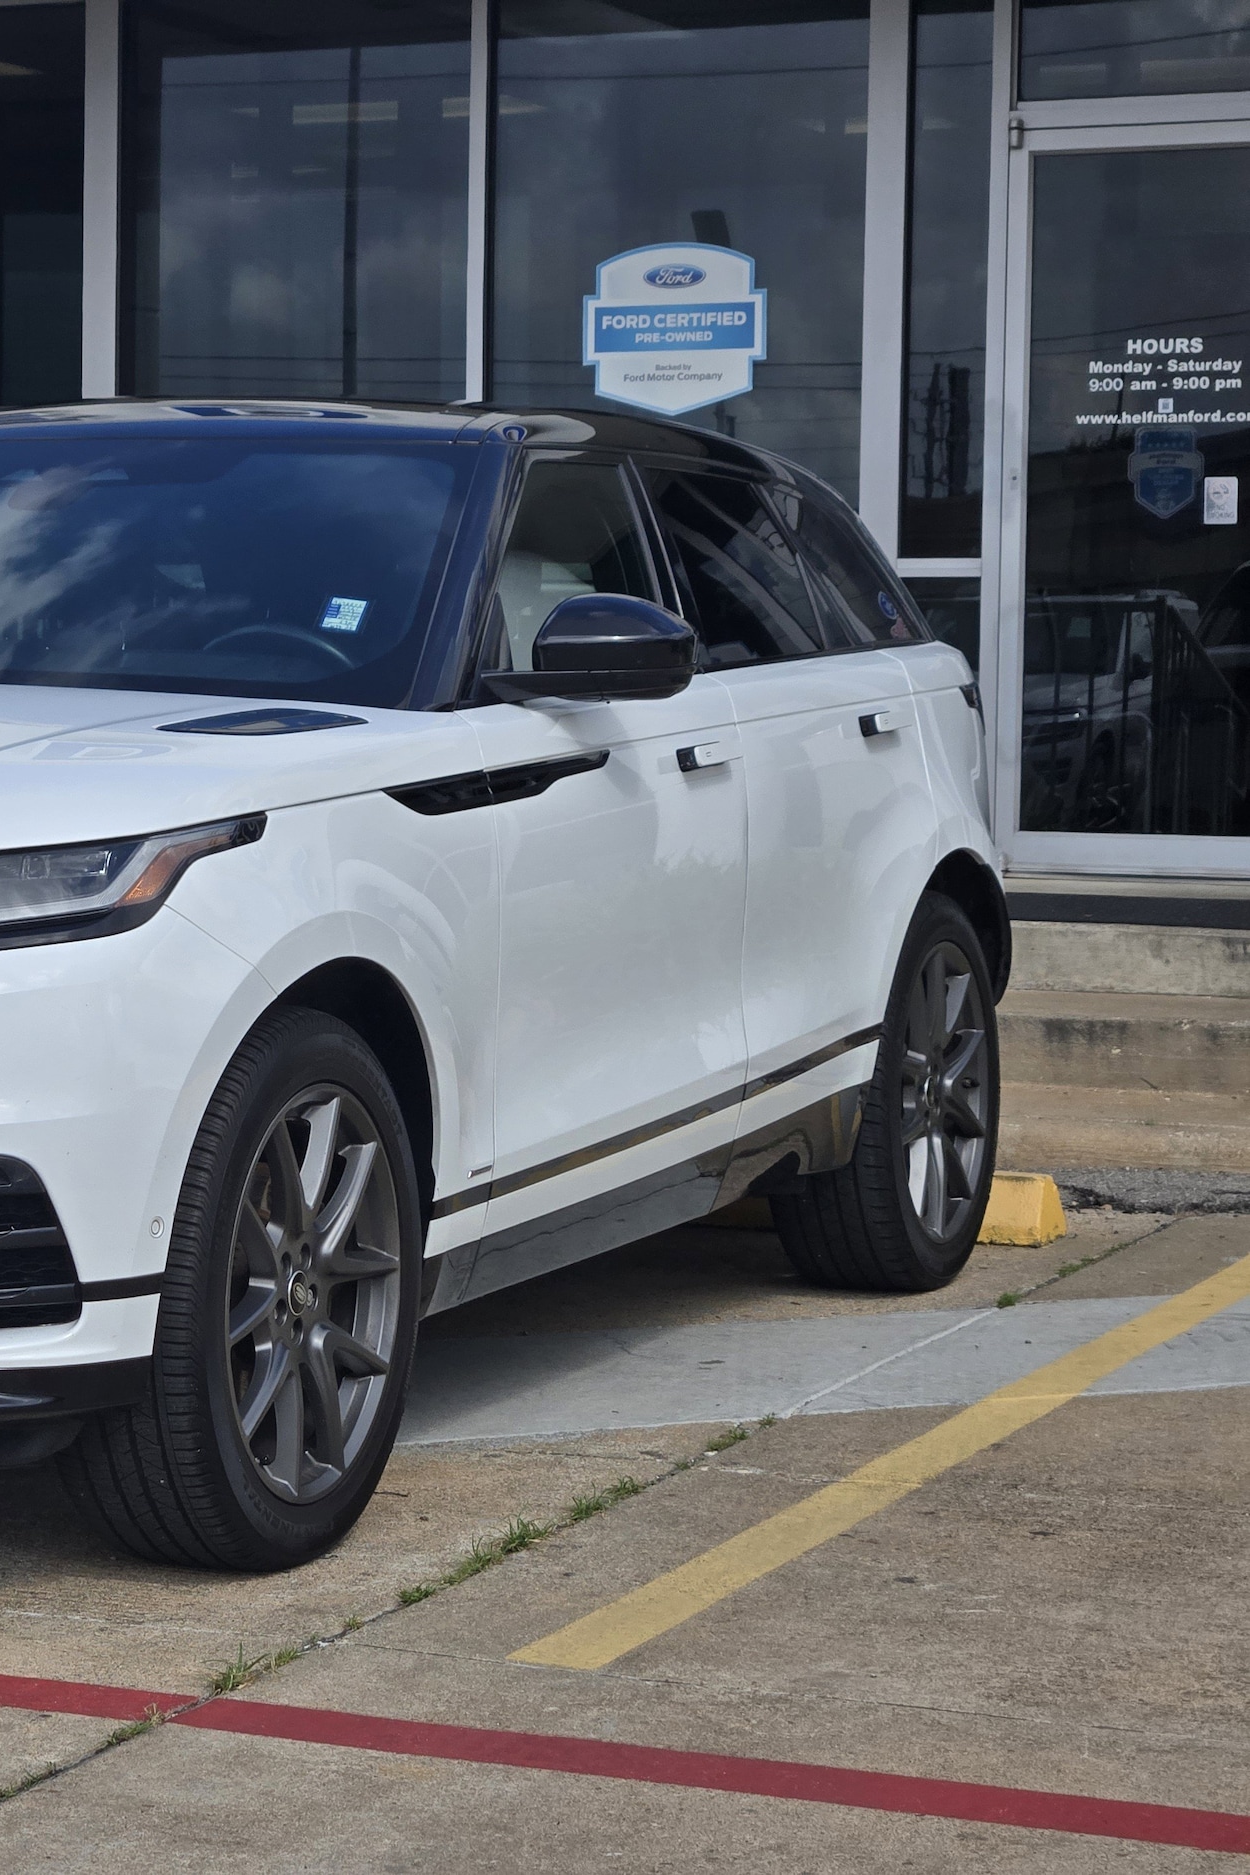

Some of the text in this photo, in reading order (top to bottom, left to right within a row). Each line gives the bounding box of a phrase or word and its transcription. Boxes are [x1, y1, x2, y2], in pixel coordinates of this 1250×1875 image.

[655, 267, 693, 285] Ford
[602, 311, 747, 330] FORD CERTIFIED
[635, 331, 713, 343] PRE-OWNED
[1127, 337, 1204, 355] HOURS
[1089, 361, 1153, 375] Monday
[1167, 358, 1243, 374] Saturday
[623, 372, 723, 384] Ford Motor Company
[1089, 378, 1124, 391] 9:00
[1130, 380, 1157, 390] am
[1172, 377, 1210, 389] 9:00
[1215, 379, 1242, 391] pm
